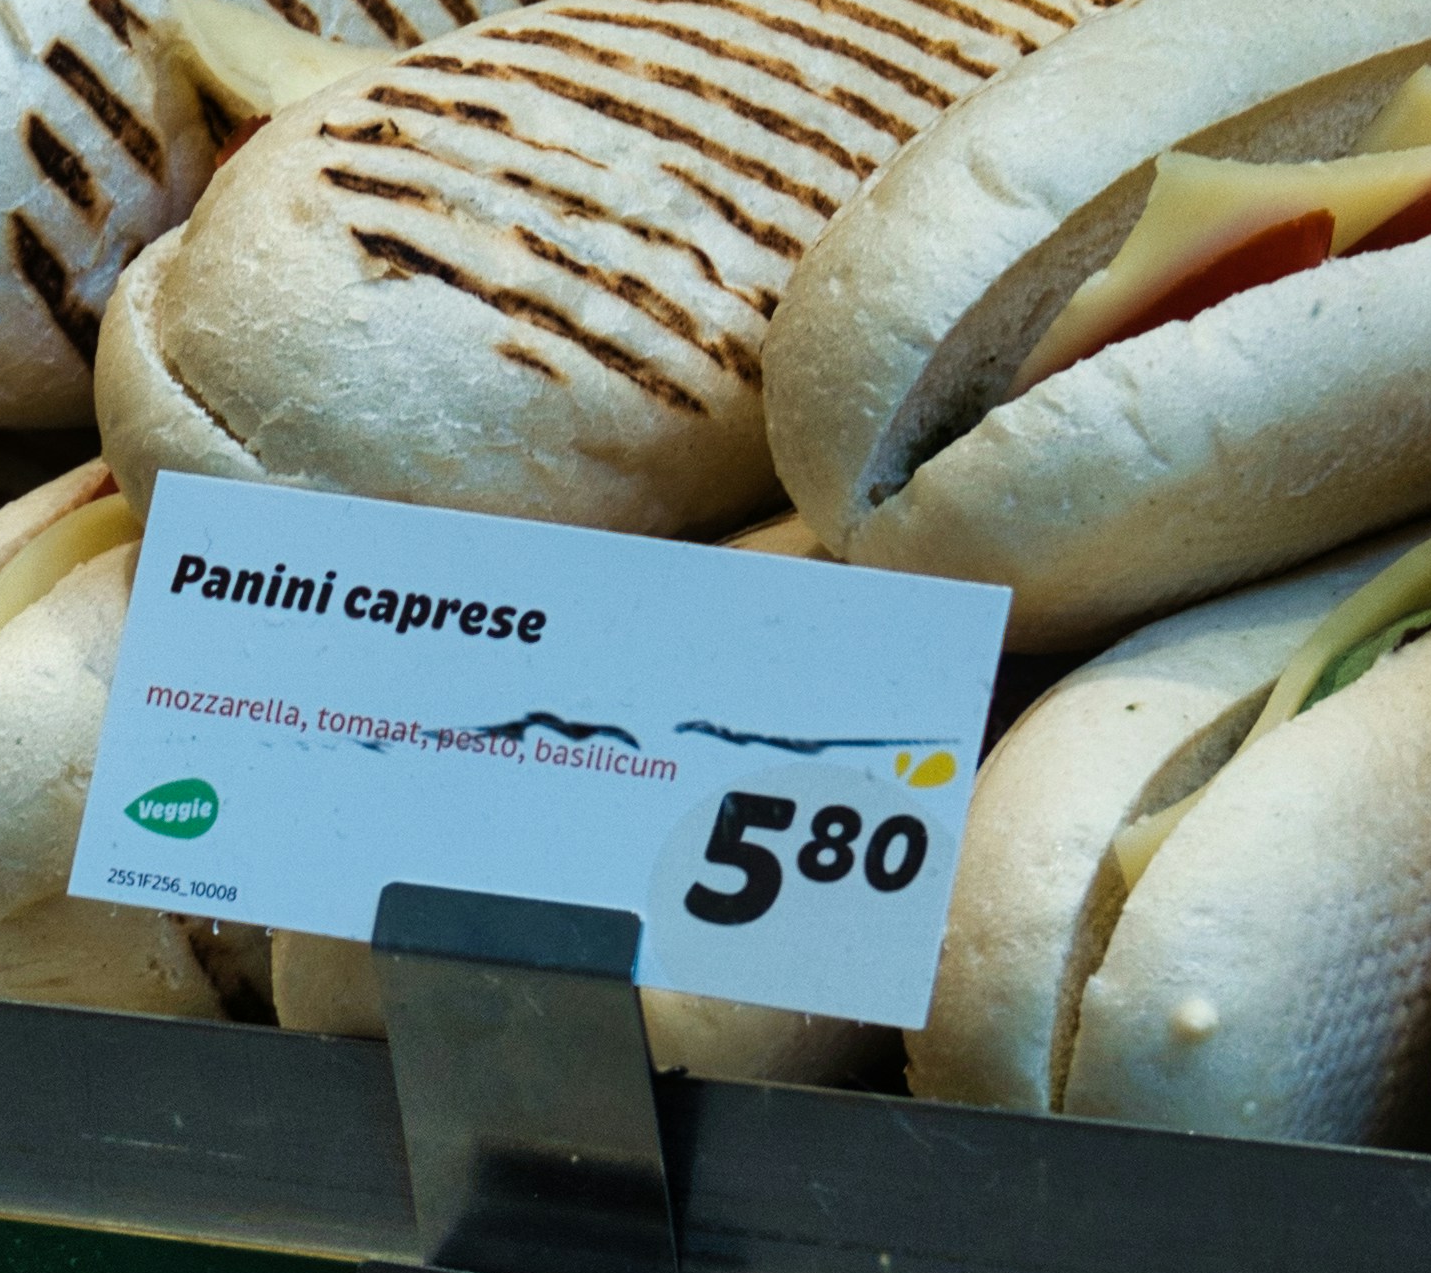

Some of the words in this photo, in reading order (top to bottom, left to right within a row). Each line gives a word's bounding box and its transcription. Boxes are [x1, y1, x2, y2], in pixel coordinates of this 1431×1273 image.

[170, 554, 337, 614] Panini
[343, 585, 547, 644] caprese
[145, 684, 308, 734] mozzarella,
[318, 707, 429, 751] tomaat,
[436, 727, 526, 764] pesto,
[534, 737, 678, 782] basilicum
[138, 797, 214, 823] Veggie
